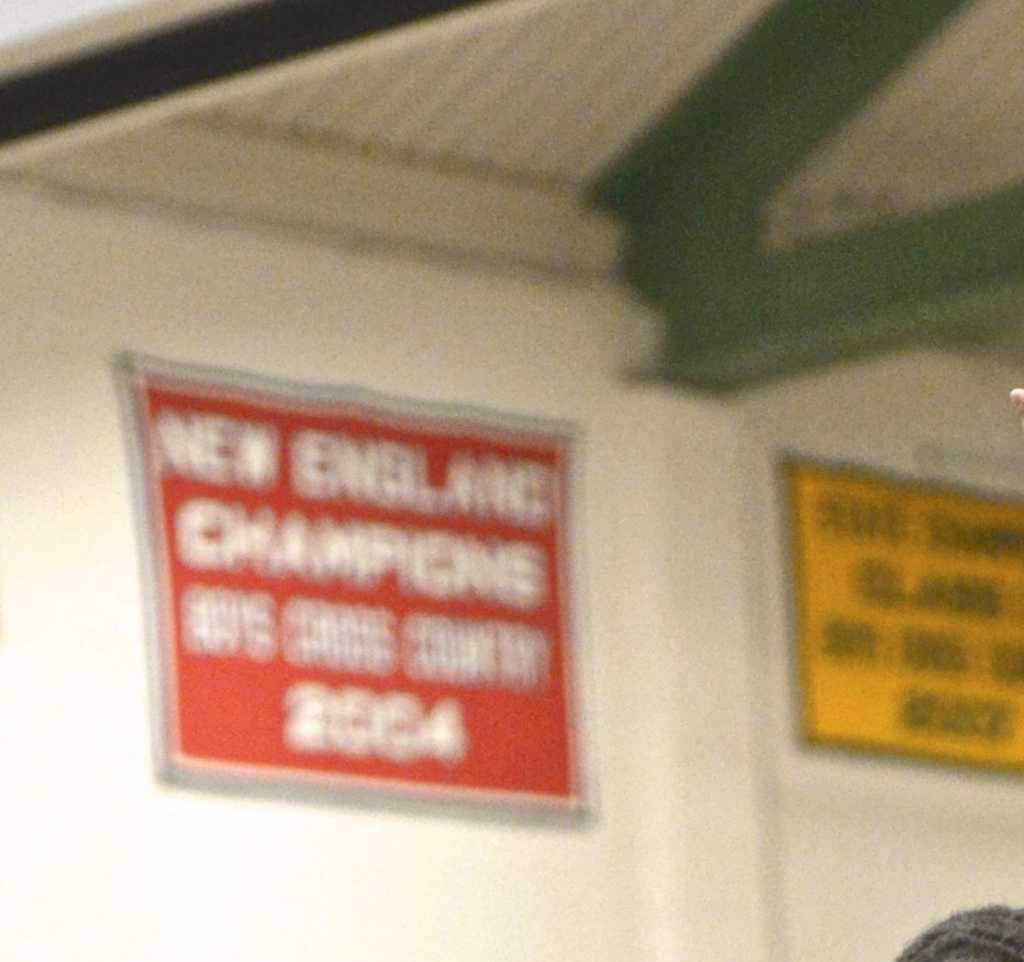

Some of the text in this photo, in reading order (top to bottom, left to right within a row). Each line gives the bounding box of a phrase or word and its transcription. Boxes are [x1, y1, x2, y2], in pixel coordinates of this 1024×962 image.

[157, 405, 549, 528] NEW ENGLAND
[174, 497, 549, 610] CHAMPIONS
[282, 682, 468, 767] 2004
